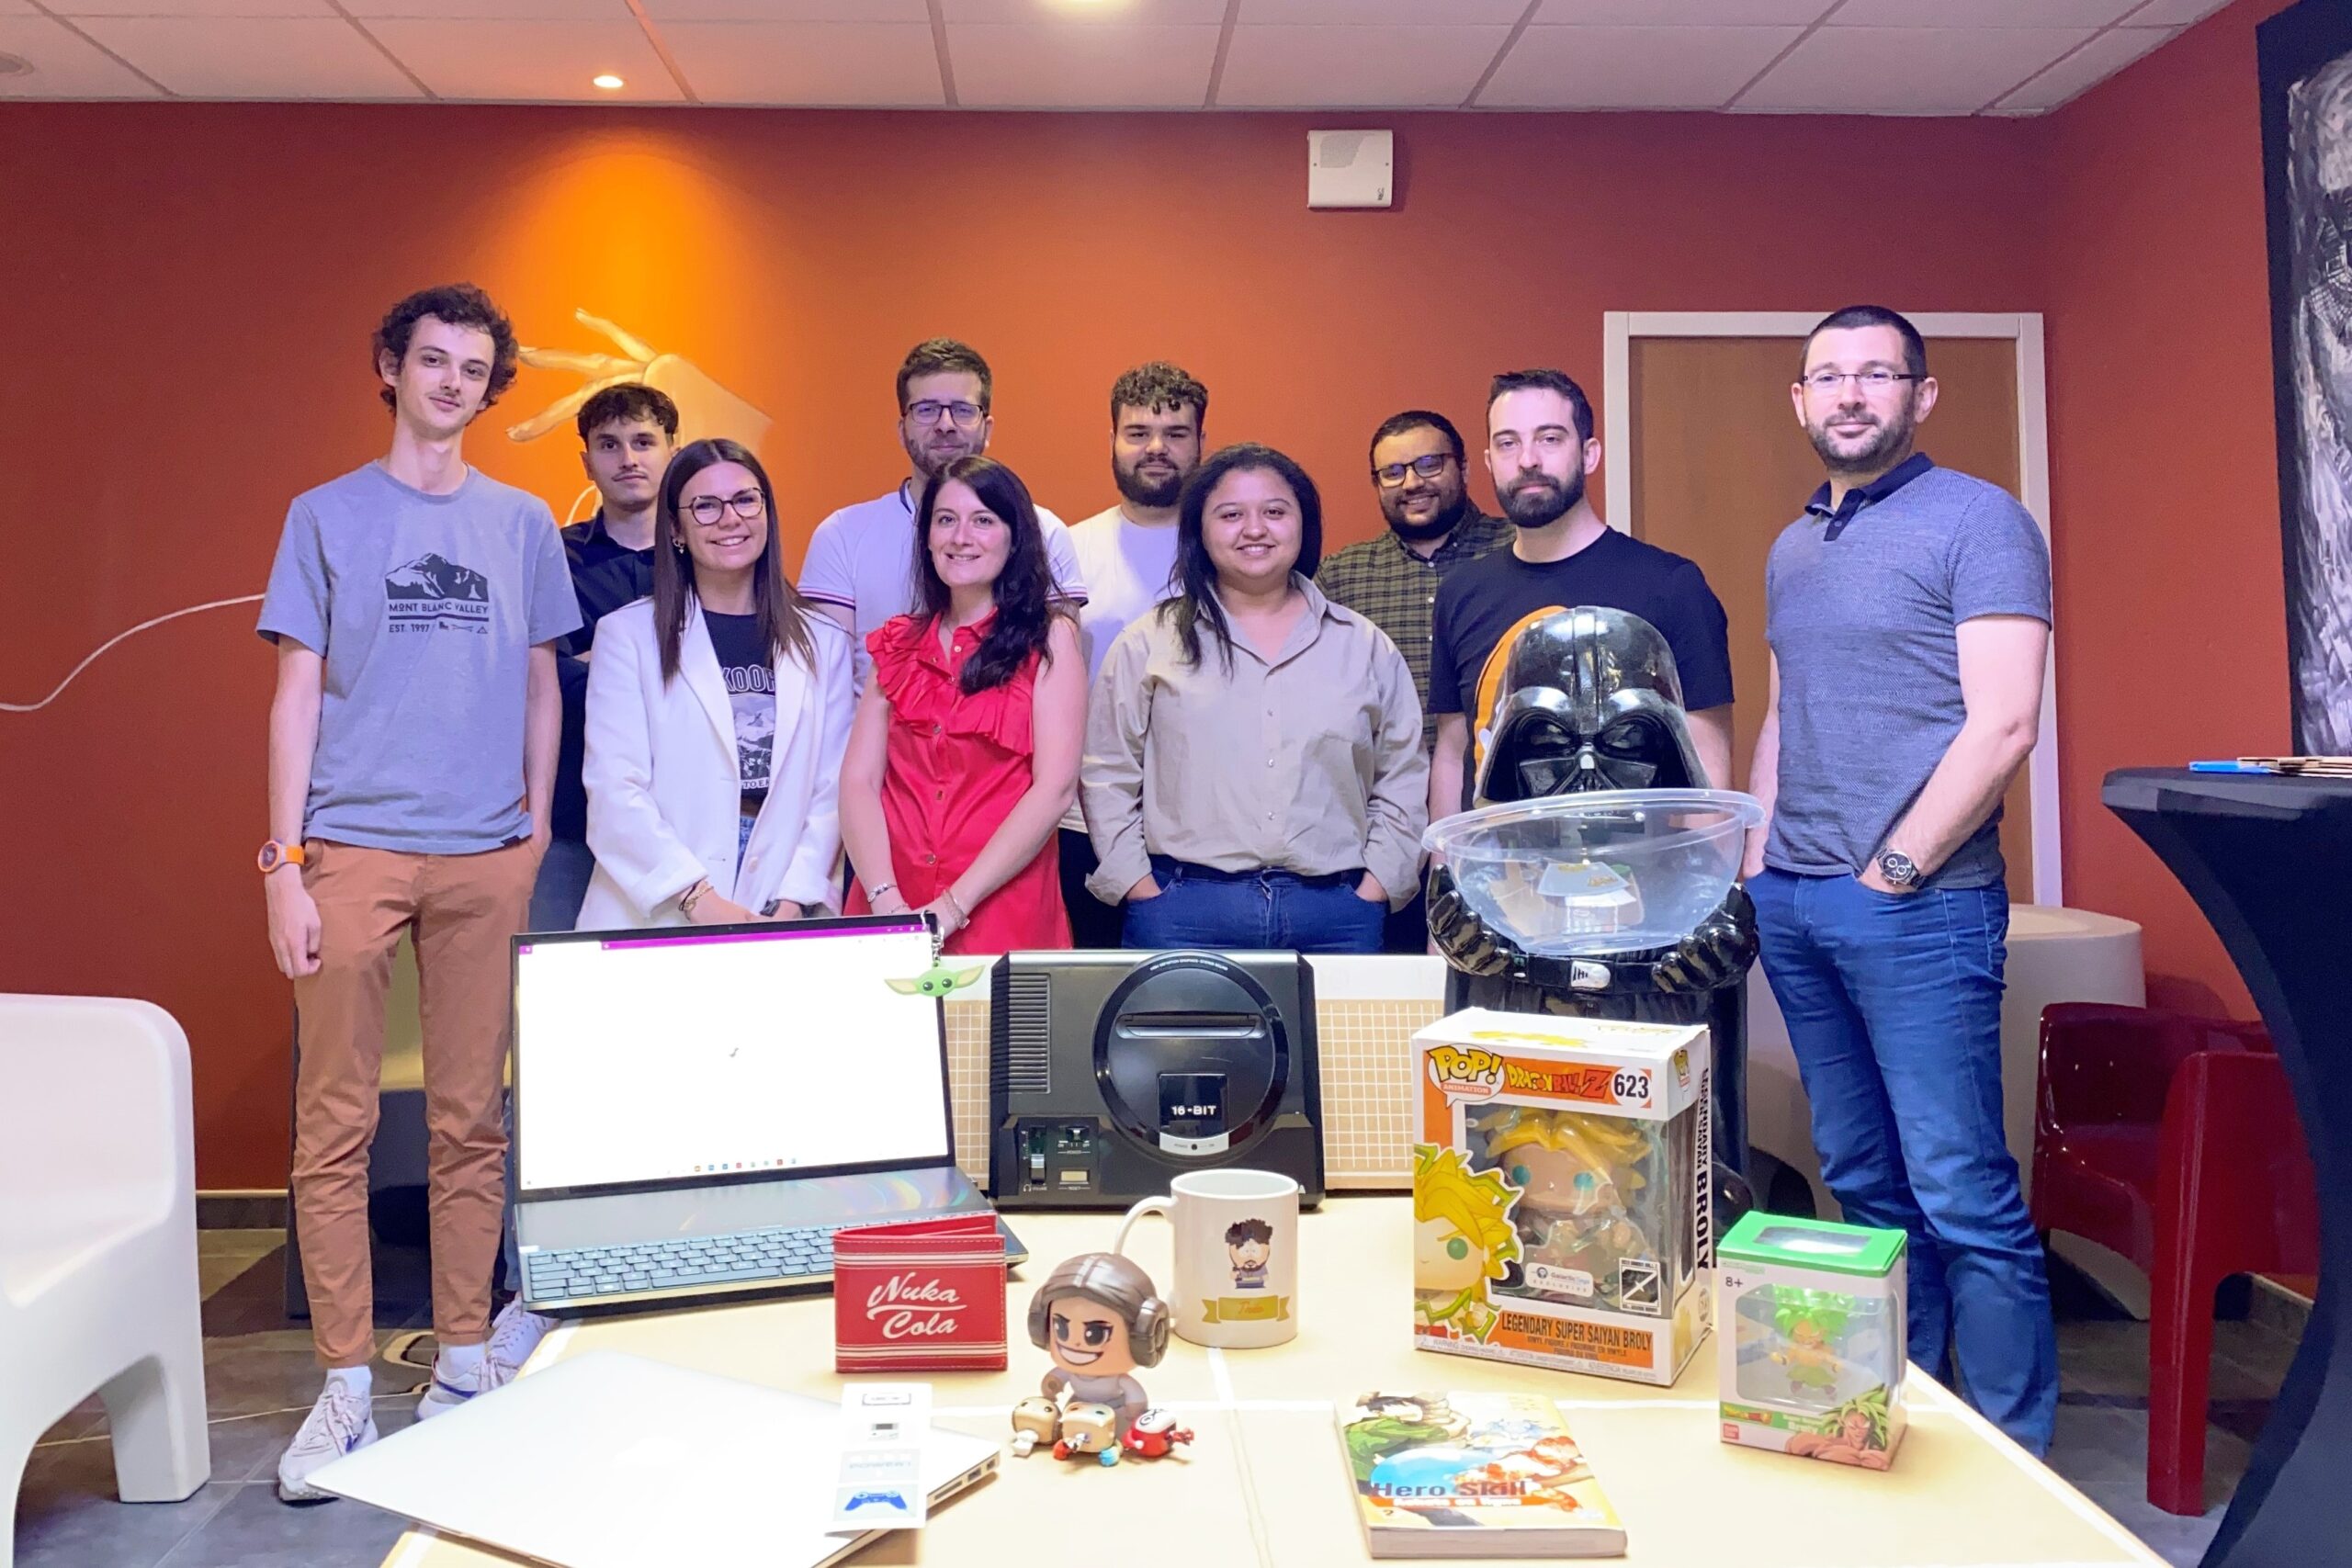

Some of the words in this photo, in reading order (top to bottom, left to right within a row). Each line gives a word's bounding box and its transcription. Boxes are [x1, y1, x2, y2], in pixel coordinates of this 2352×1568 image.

[389, 603, 418, 613] MONT
[421, 602, 452, 613] BLANC
[455, 604, 488, 614] VALLEY
[411, 624, 430, 633] 1997
[1427, 1045, 1504, 1085] POP!
[1443, 1084, 1490, 1094] ANIMATION
[1613, 1073, 1649, 1099] 623
[1171, 1105, 1216, 1116] 16-BIT
[1696, 1170, 1709, 1269] BROLY
[866, 1271, 960, 1307] Nuka
[1725, 1276, 1744, 1288] 8+
[882, 1311, 958, 1339] Cola
[1501, 1313, 1553, 1336] LEGENDARY
[1555, 1321, 1585, 1341] SUPER
[1588, 1325, 1620, 1347] SAIYAN
[1623, 1331, 1653, 1351] BROLY
[1374, 1483, 1446, 1496] Hero
[1459, 1481, 1526, 1496] Skill
